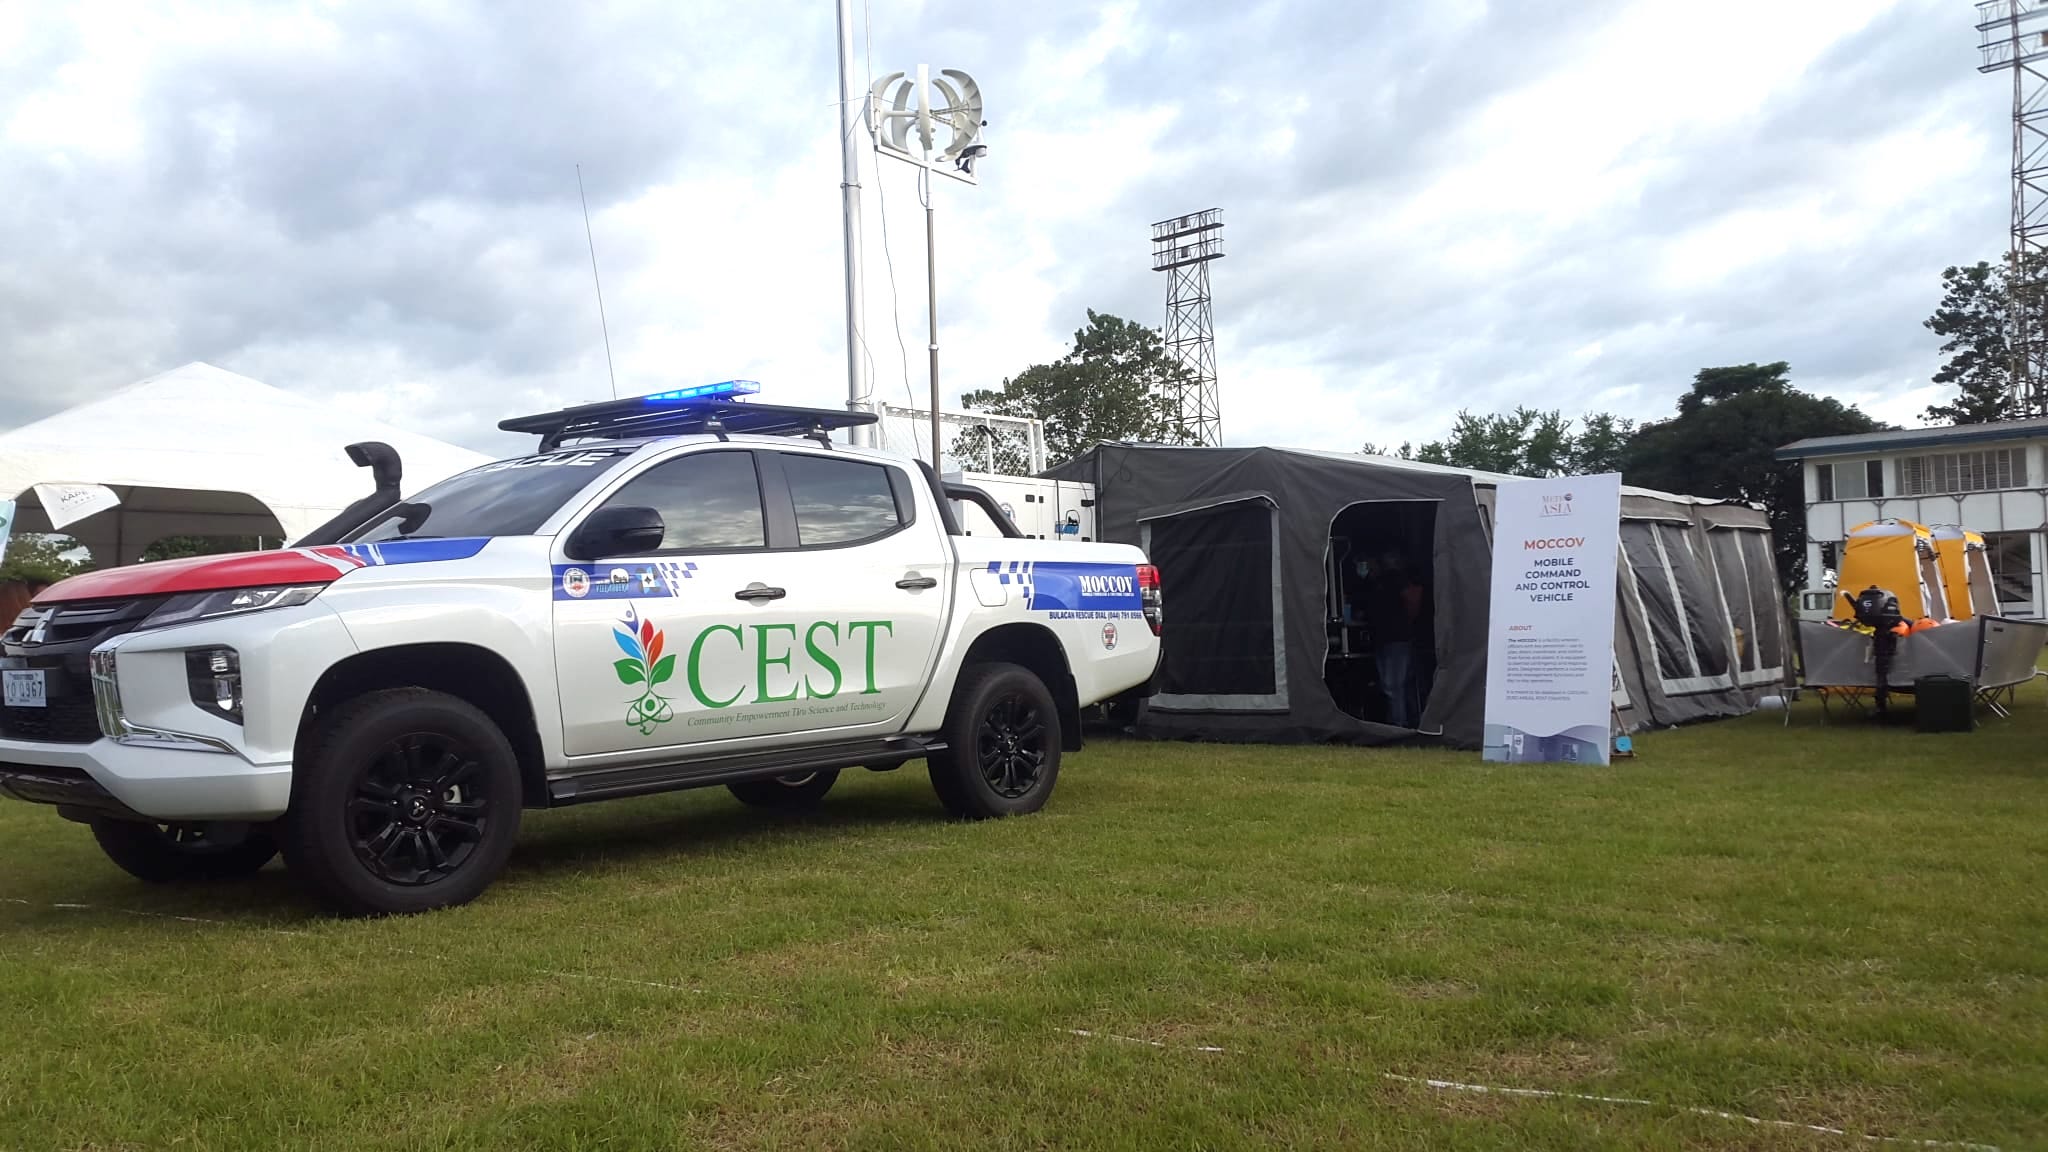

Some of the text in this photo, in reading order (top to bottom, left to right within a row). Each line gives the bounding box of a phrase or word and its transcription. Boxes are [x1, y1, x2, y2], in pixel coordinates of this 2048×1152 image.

[1524, 537, 1585, 550] MOCCOV
[1534, 557, 1574, 567] MOBILE
[1525, 568, 1581, 579] COMMAND
[1078, 575, 1133, 593] MOCCOV
[1515, 580, 1590, 591] AND CONTROL
[1530, 592, 1574, 602] VEHICLE
[1049, 611, 1075, 620] BULACAN
[1075, 611, 1094, 620] RESCUE
[1095, 611, 1107, 620] DIAL
[687, 620, 893, 709] CEST
[688, 701, 886, 727] Community Empowerment Thru Science and Technology
